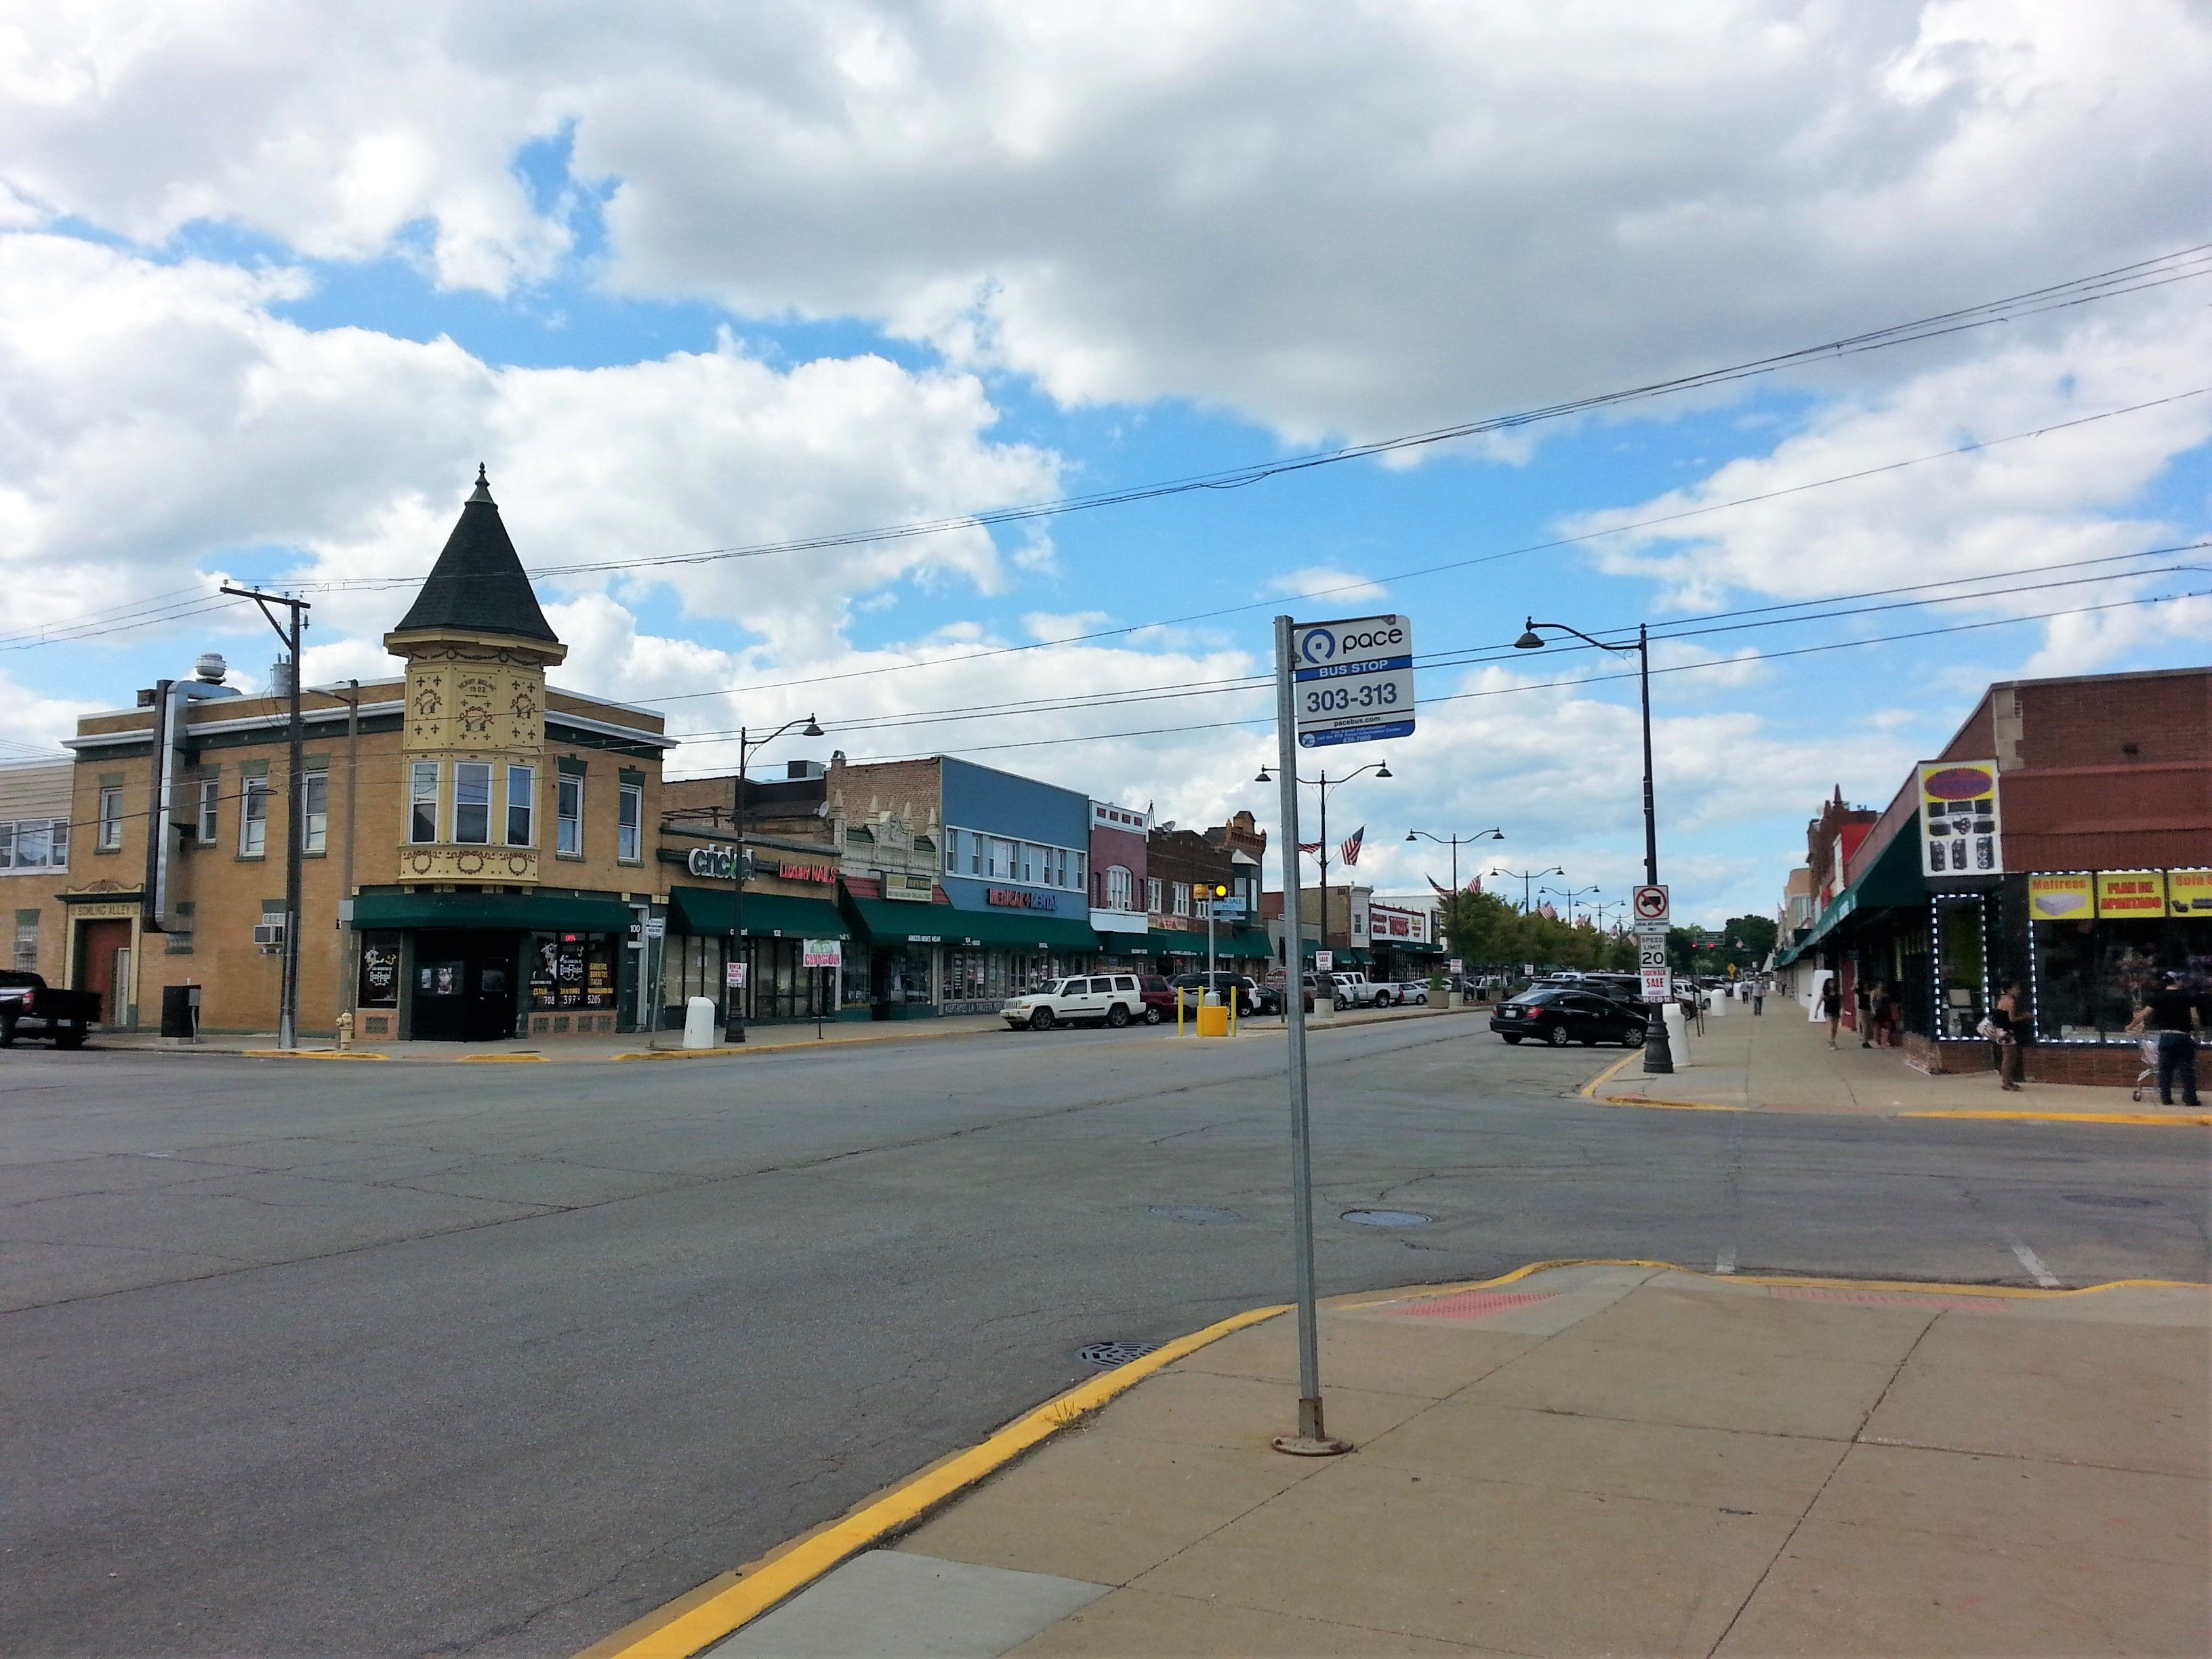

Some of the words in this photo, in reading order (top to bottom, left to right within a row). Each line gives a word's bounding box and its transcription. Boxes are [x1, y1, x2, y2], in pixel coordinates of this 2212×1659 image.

[1343, 628, 1404, 654] pace
[1319, 667, 1347, 678] BUS
[1351, 659, 1389, 673] STOP
[1307, 682, 1397, 713] 303-313
[1333, 716, 1381, 728] pacebus.com
[779, 859, 811, 880] LUXURY
[812, 864, 837, 884] NAILS
[2032, 880, 2086, 890] Mattress
[989, 887, 1023, 907] MEDICAL
[108, 905, 129, 915] ALLEY
[630, 924, 640, 933] 100
[1641, 951, 1664, 965] 20
[1646, 977, 1664, 988] SALE
[544, 996, 555, 1004] 708
